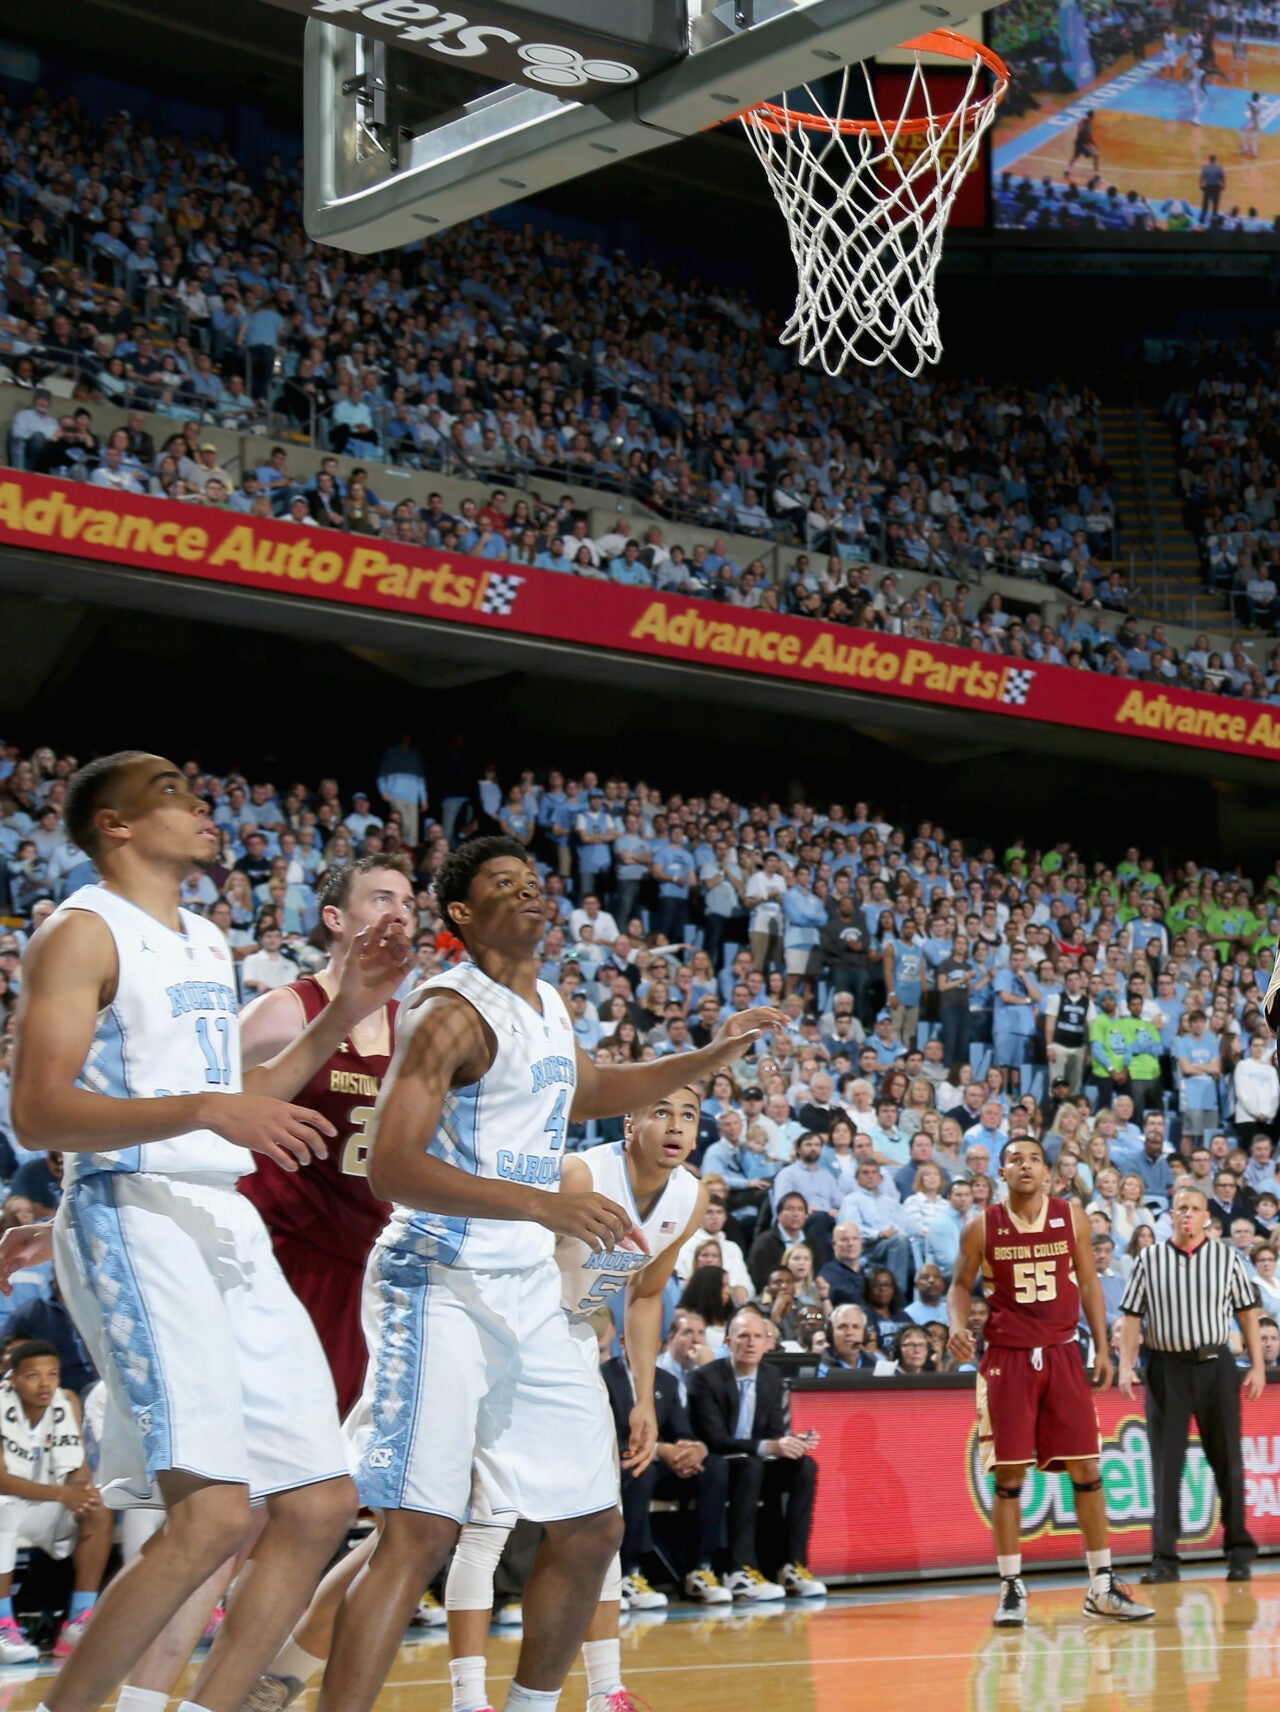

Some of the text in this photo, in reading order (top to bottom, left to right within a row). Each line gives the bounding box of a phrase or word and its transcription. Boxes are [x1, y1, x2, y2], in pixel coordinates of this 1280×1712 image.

[0, 483, 474, 608] Advance Auto Parts
[631, 602, 998, 699] Advance Auto Parts
[1115, 690, 1247, 742] Advance
[195, 1017, 232, 1085] 11
[544, 1089, 567, 1150] 4
[582, 1250, 654, 1273] NORT
[994, 1240, 1070, 1260] BOSTON COLLEGE
[578, 1274, 629, 1310] 5
[1013, 1261, 1057, 1304] 55
